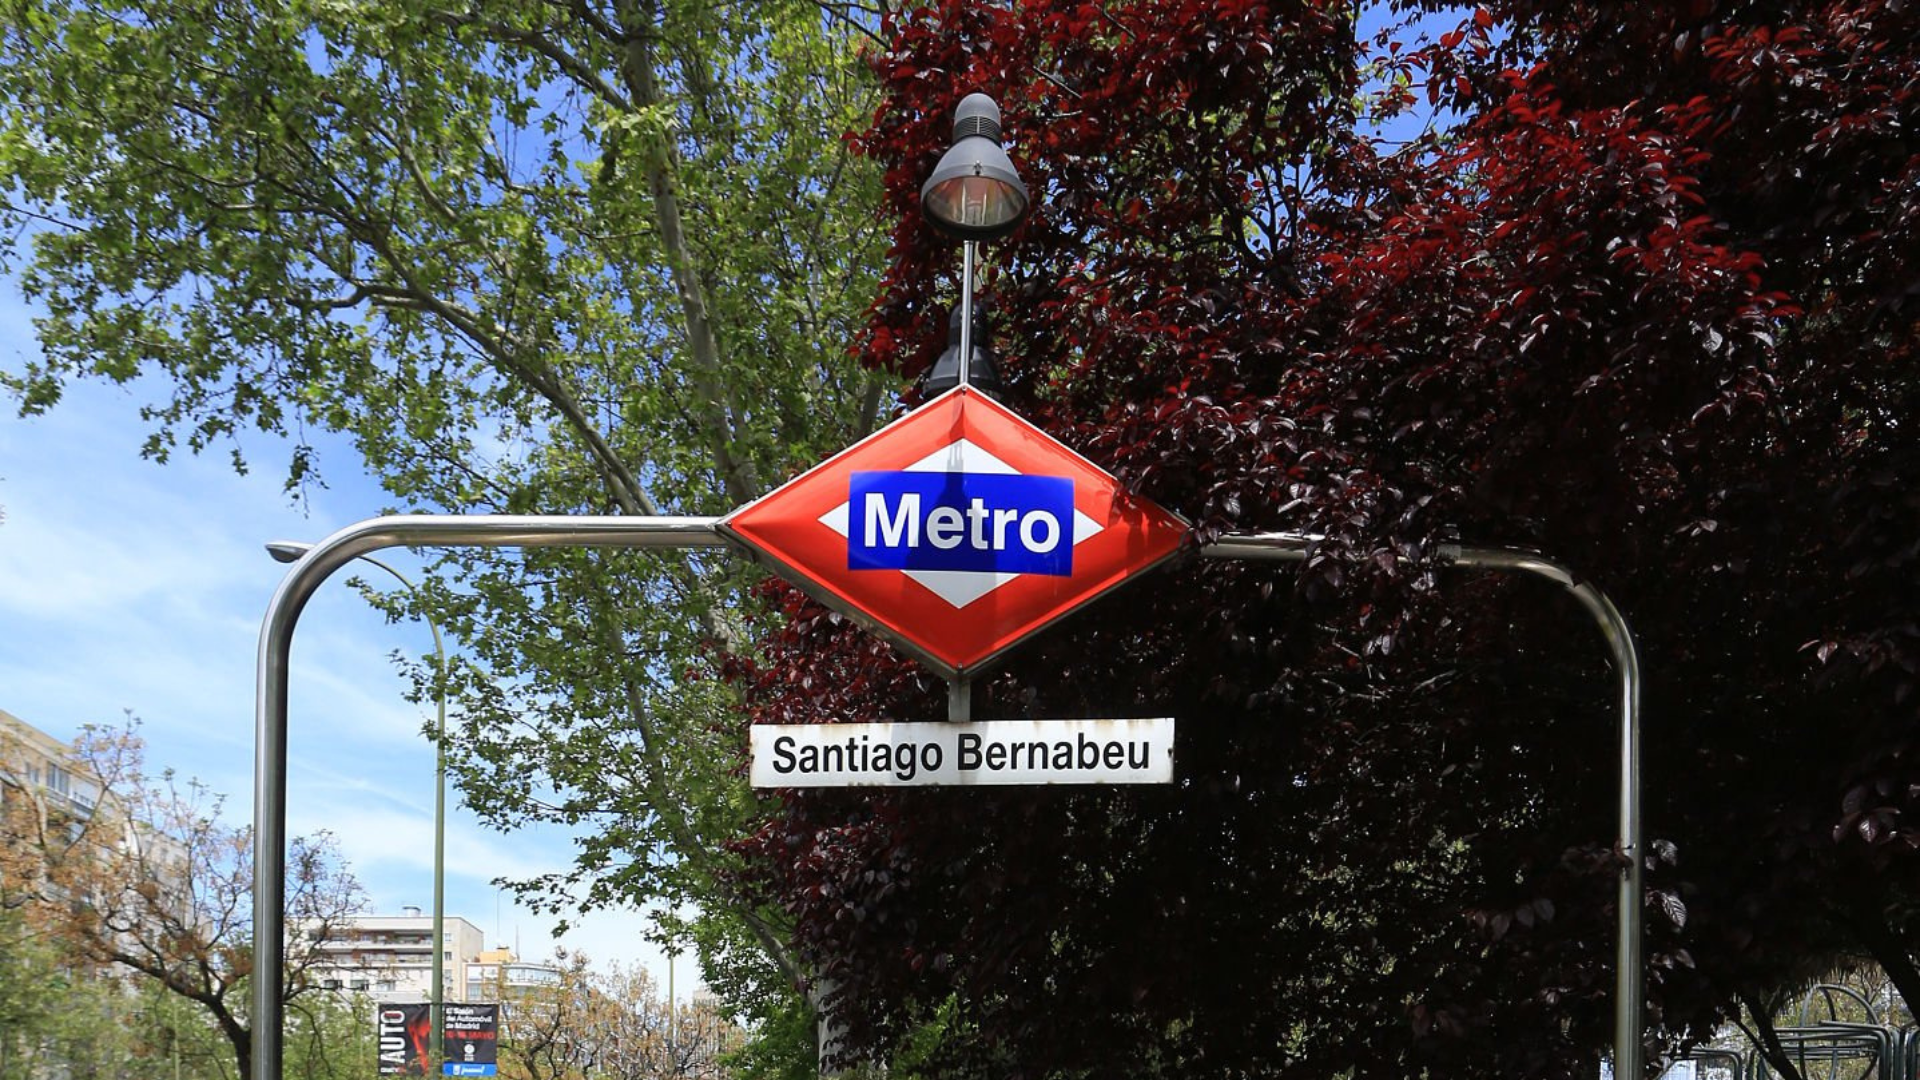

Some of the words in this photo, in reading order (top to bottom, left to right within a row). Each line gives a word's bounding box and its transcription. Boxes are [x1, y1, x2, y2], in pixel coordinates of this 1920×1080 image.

[864, 492, 1061, 554] Metro
[772, 735, 943, 781] Santiago
[957, 733, 1150, 772] Bernabeu
[380, 1010, 406, 1064] AUTO
